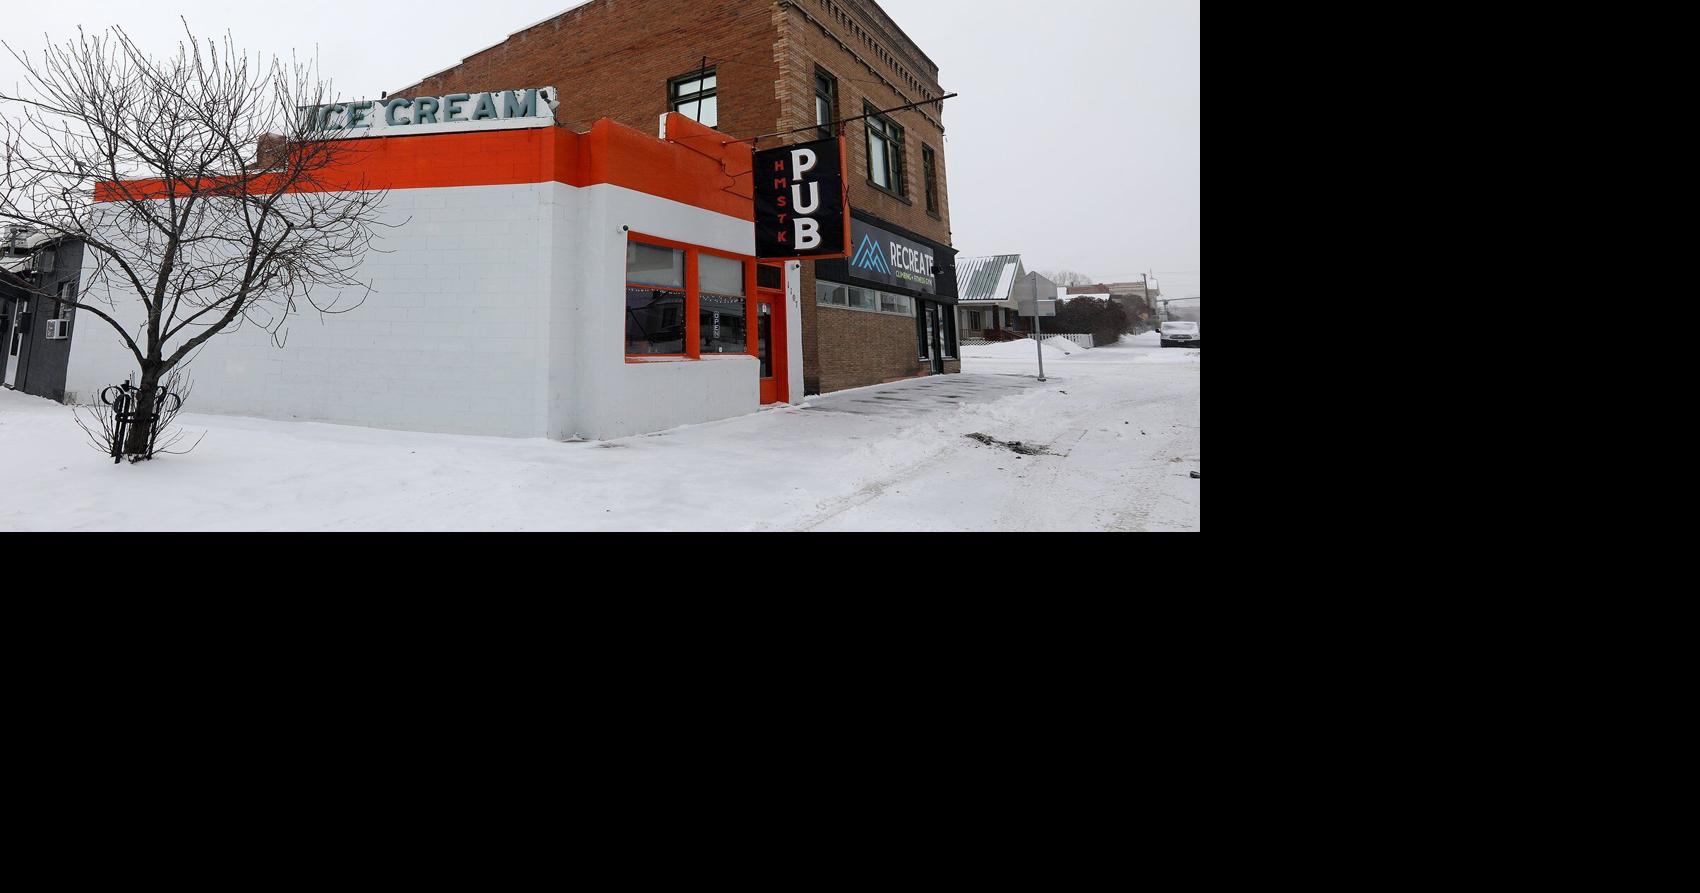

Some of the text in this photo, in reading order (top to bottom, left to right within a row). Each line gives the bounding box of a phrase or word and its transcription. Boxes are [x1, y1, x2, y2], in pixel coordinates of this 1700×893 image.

[385, 89, 537, 127] CREAM
[774, 160, 787, 242] HMSTK
[791, 148, 821, 250] PUB
[890, 241, 934, 278] RECREATE
